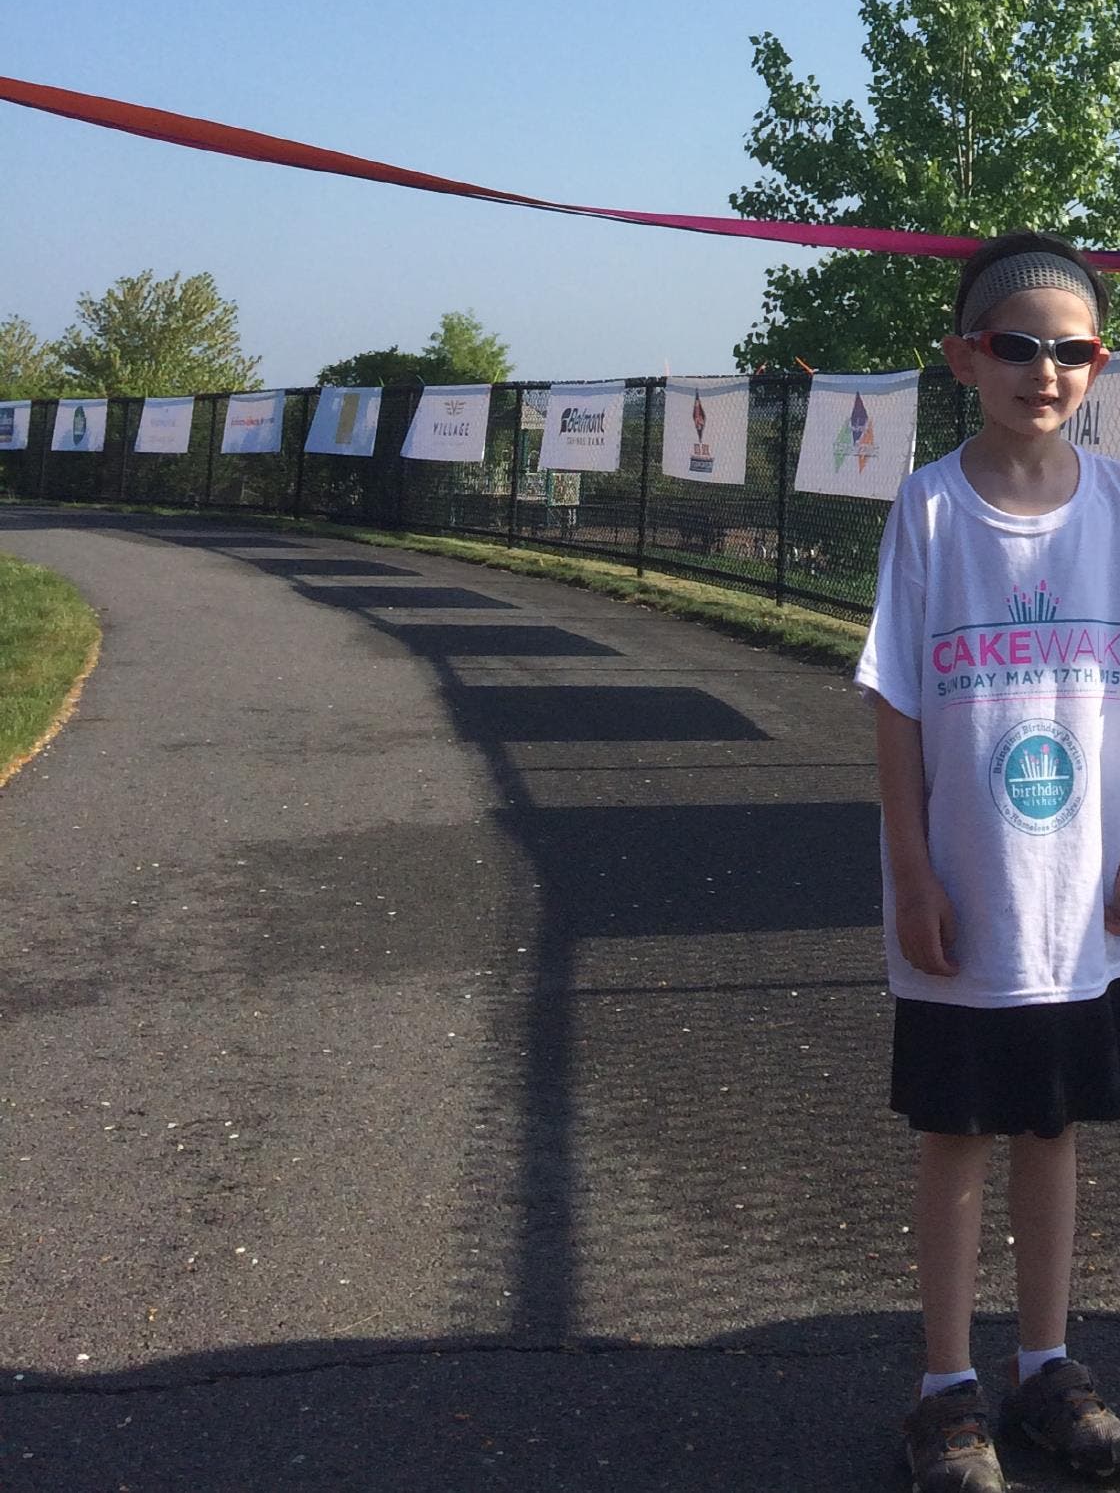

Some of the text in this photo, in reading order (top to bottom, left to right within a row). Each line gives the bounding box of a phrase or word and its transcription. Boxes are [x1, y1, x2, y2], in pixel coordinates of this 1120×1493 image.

[433, 422, 470, 437] VILLAGE
[568, 407, 605, 433] Belmont
[1060, 400, 1100, 445] ITAL
[1006, 669, 1044, 686] MAY
[1021, 723, 1062, 738] Birthday
[1061, 731, 1083, 772] Parties
[1012, 782, 1065, 799] birthday
